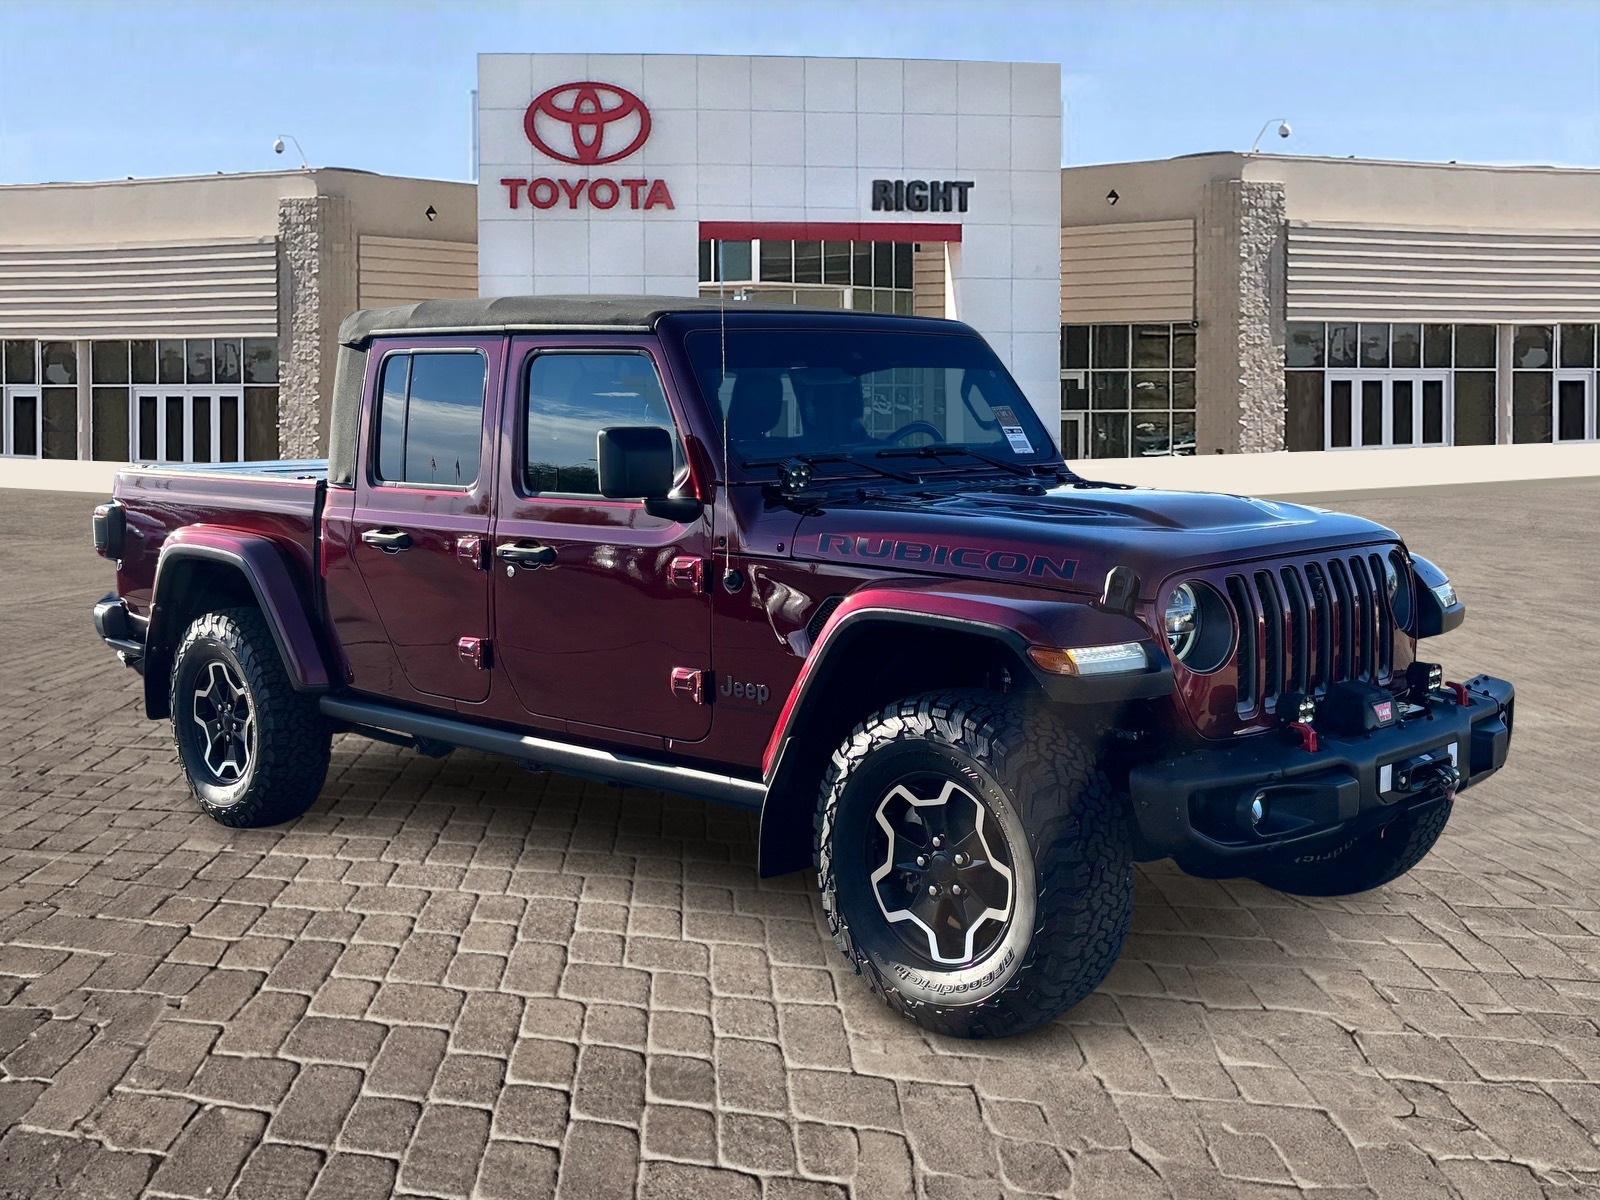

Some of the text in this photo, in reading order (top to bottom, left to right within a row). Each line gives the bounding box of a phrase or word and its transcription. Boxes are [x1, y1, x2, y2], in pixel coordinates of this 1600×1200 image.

[500, 178, 675, 210] TOYOTA
[871, 179, 975, 212] RIGHT
[817, 532, 1080, 581] RUBICON
[719, 675, 771, 705] Jeep
